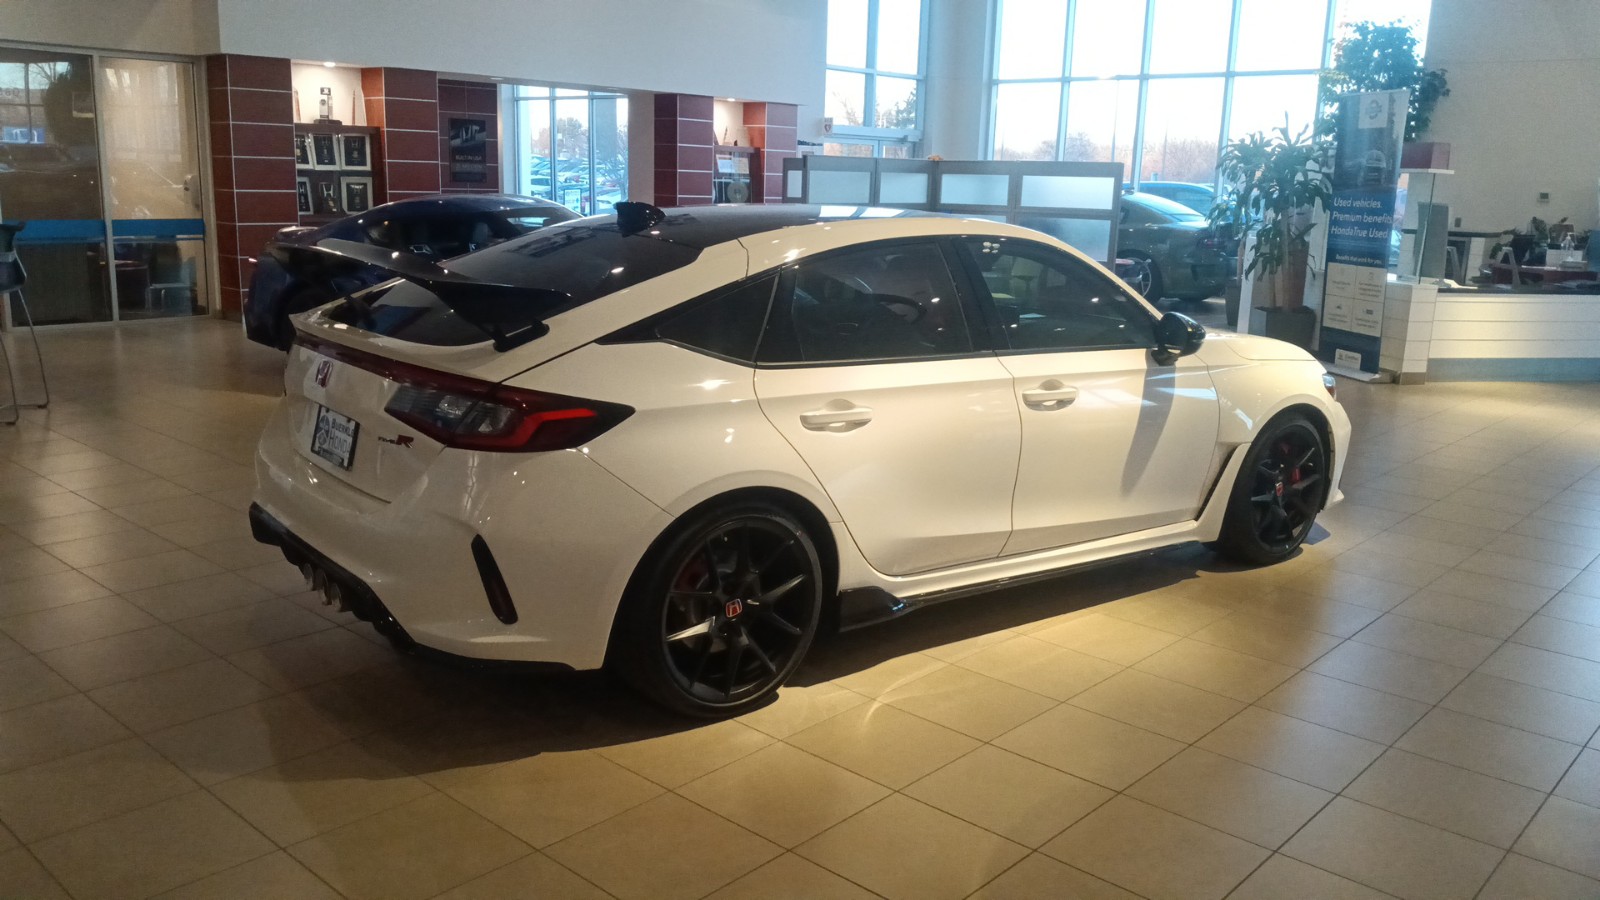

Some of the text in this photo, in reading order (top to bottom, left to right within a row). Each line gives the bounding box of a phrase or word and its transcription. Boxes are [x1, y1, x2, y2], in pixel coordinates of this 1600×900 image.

[1333, 197, 1352, 207] Used
[1332, 211, 1362, 222] Premium
[1331, 225, 1367, 237] HondaTrue
